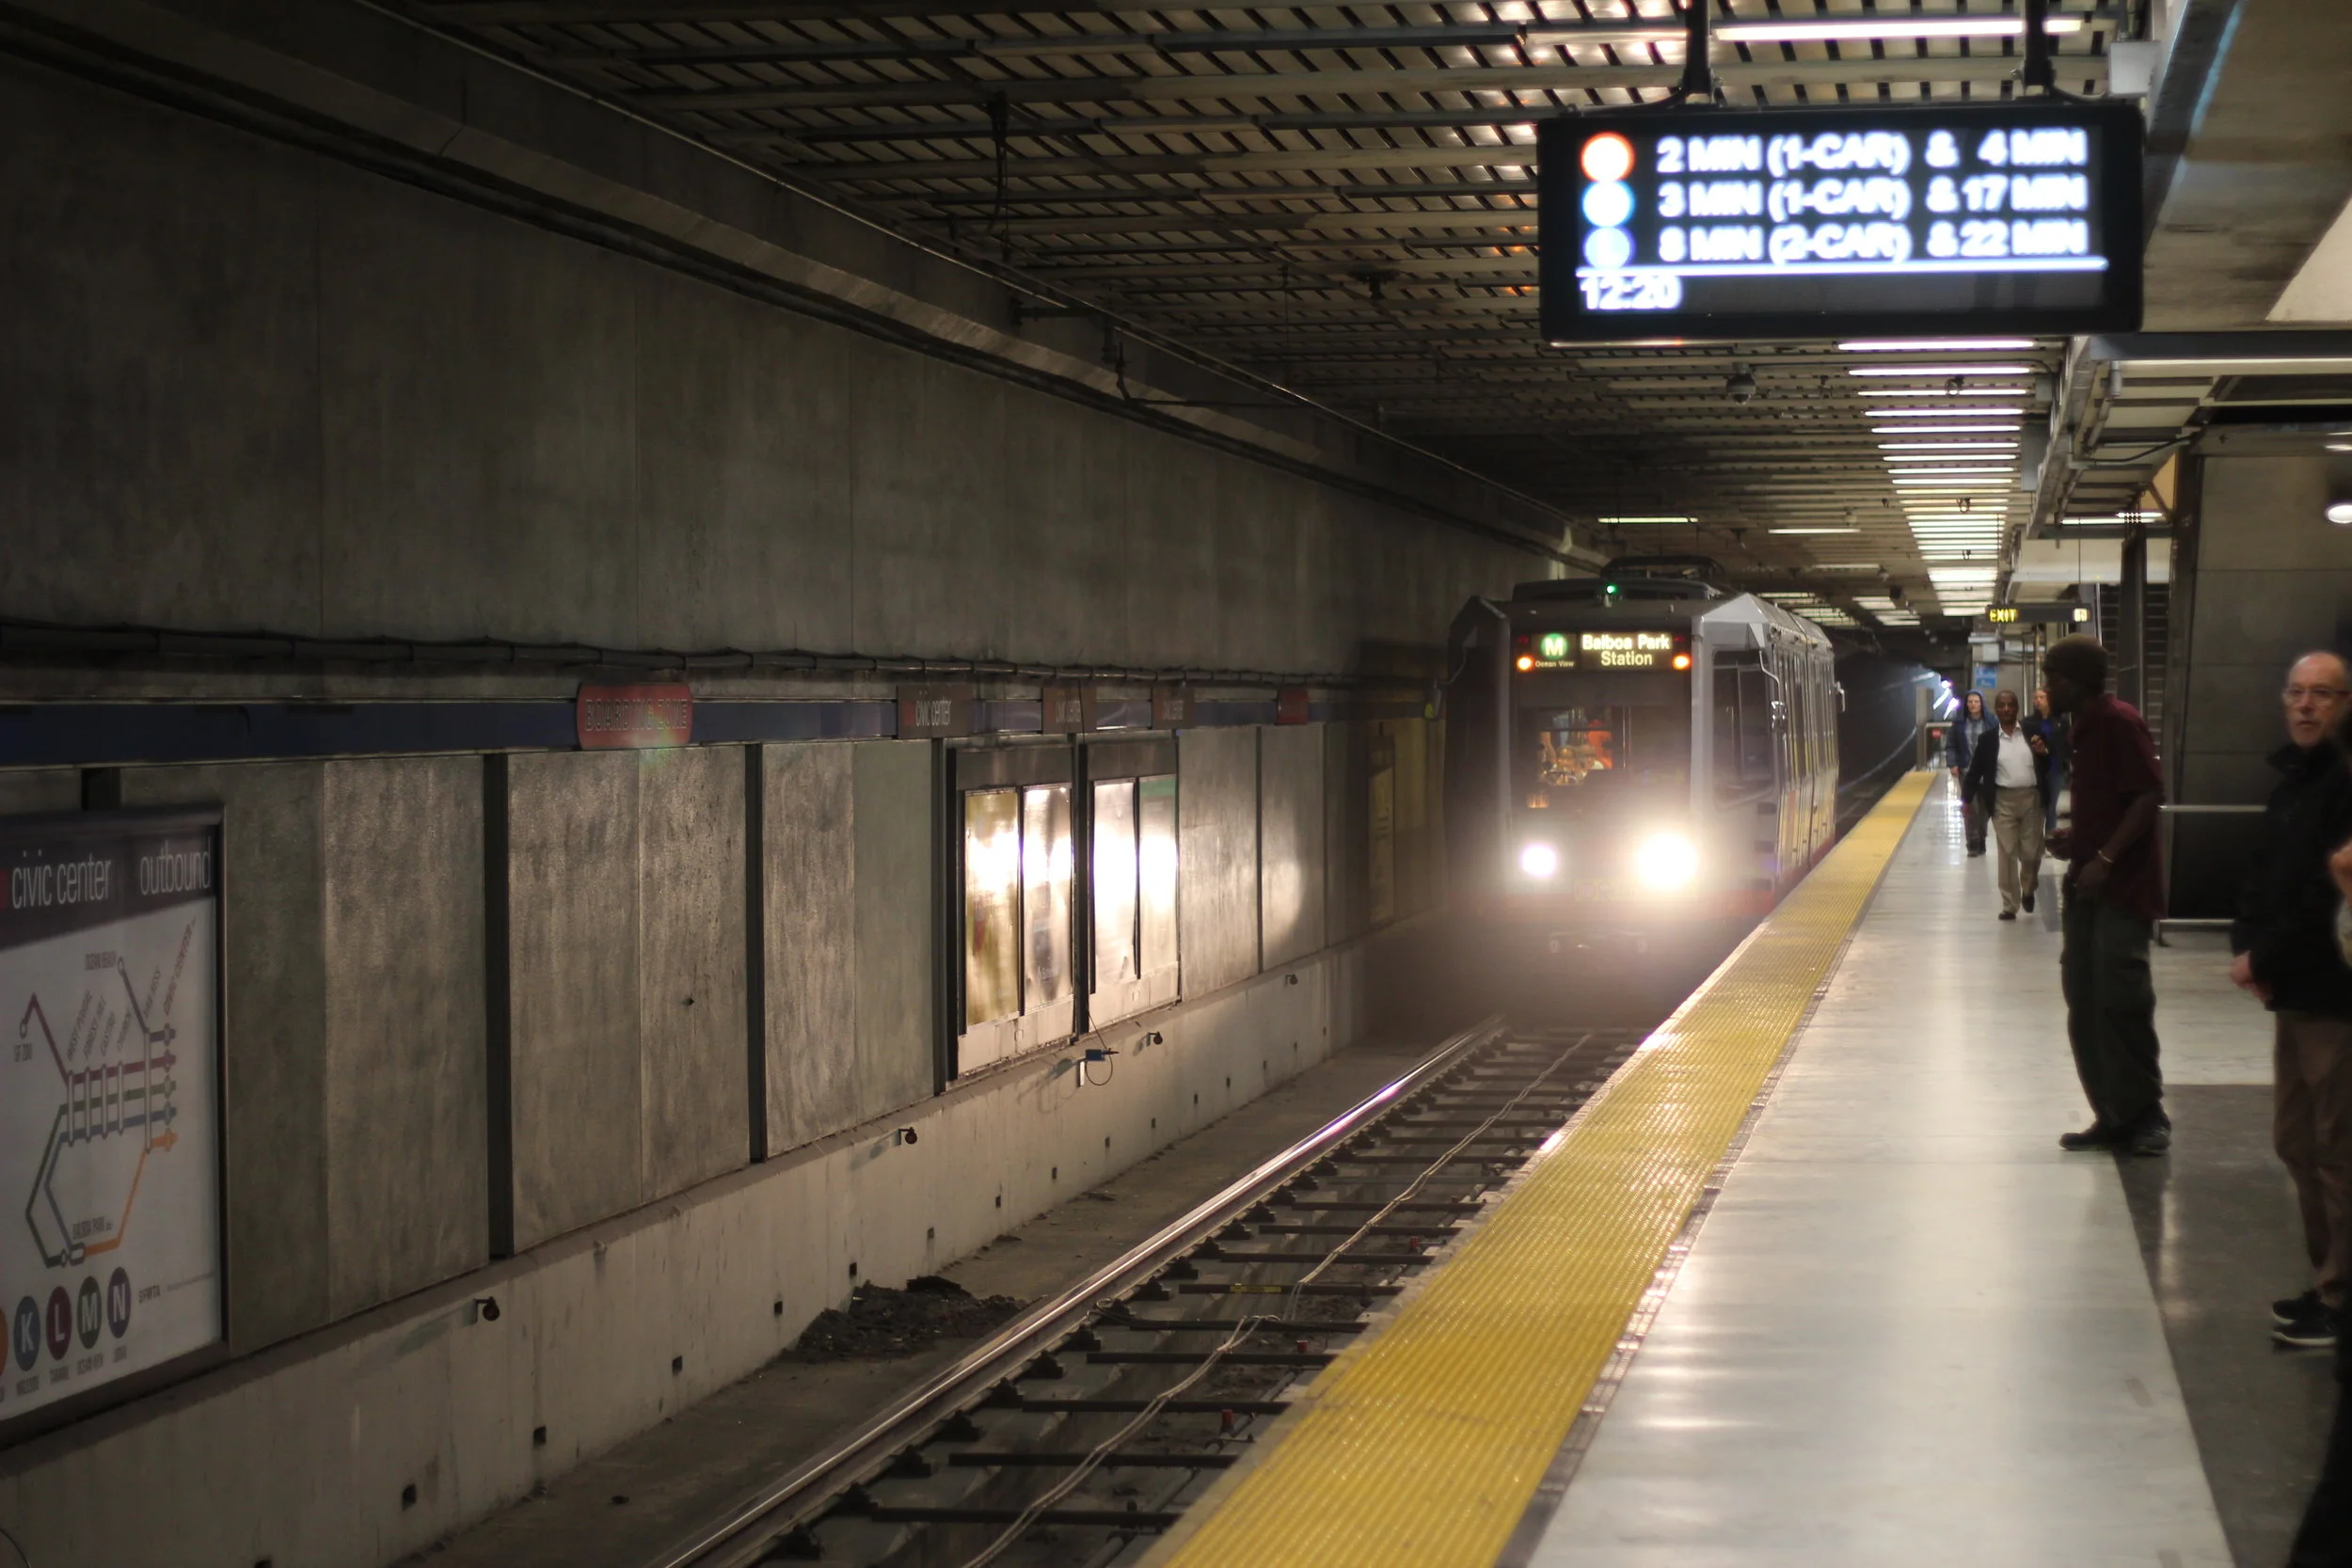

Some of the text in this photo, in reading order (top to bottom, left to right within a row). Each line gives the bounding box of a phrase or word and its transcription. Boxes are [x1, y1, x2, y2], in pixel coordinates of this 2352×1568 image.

[1658, 137, 1686, 173] 2
[1689, 137, 1763, 173] MIN
[1768, 133, 1912, 178] (1-CAR)
[1925, 131, 1960, 167] &
[1978, 131, 2010, 166] 4
[2010, 129, 2087, 166] MIN
[1659, 182, 1686, 217] 3
[1690, 181, 1764, 217] MIN
[1769, 177, 1912, 223] (1-CAR)
[1926, 176, 1960, 213] &
[1962, 174, 2010, 211] 17
[2010, 174, 2088, 211] MIN
[1659, 226, 1687, 261] 8
[1690, 226, 1765, 261] MIN
[1769, 222, 1913, 264] (2-CAR)
[1927, 220, 1960, 257] &
[1961, 219, 2010, 257] 22
[2010, 219, 2088, 256] MIN
[1581, 276, 1681, 309] 12:20
[1989, 608, 2018, 623] EXIT
[1544, 636, 1565, 657] M
[1581, 634, 1671, 650] Balboa Park
[1600, 651, 1653, 666] Station
[1534, 660, 1575, 669] Ocean View
[584, 698, 689, 732] BOARDING ZONE
[10, 849, 112, 910] civic center
[140, 835, 211, 895] outbound
[54, 1303, 66, 1342] L
[81, 1292, 98, 1334] M
[113, 1282, 126, 1323] N
[21, 1311, 34, 1354] K
